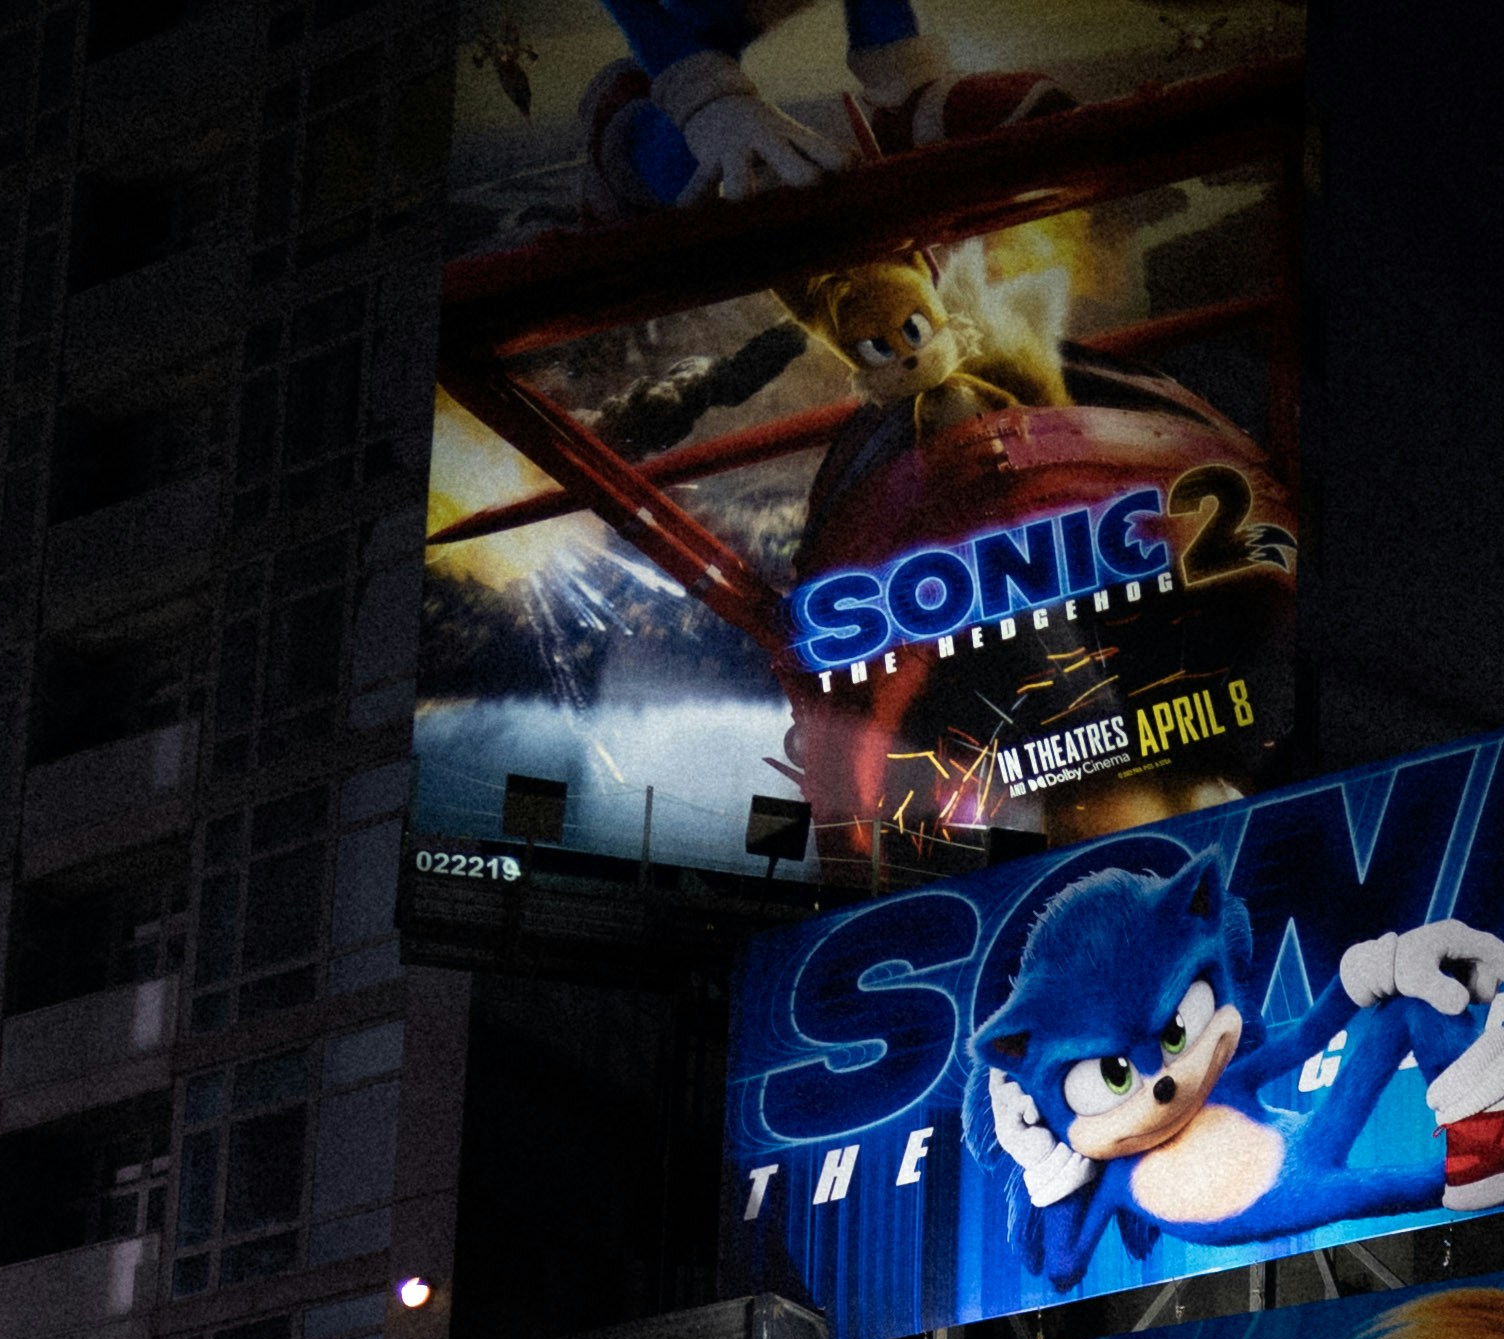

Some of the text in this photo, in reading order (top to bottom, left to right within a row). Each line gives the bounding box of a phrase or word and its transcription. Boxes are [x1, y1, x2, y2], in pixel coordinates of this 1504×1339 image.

[805, 464, 1297, 665] SONIC 2
[819, 571, 1175, 693] THE HEDGEHOG
[997, 679, 1254, 784] IN THEATRES APRIL 8
[1009, 783, 1026, 798] AND
[1045, 767, 1082, 788] Dolby
[1083, 752, 1130, 774] Cinema
[416, 850, 521, 882] 022219
[739, 1124, 934, 1221] THE
